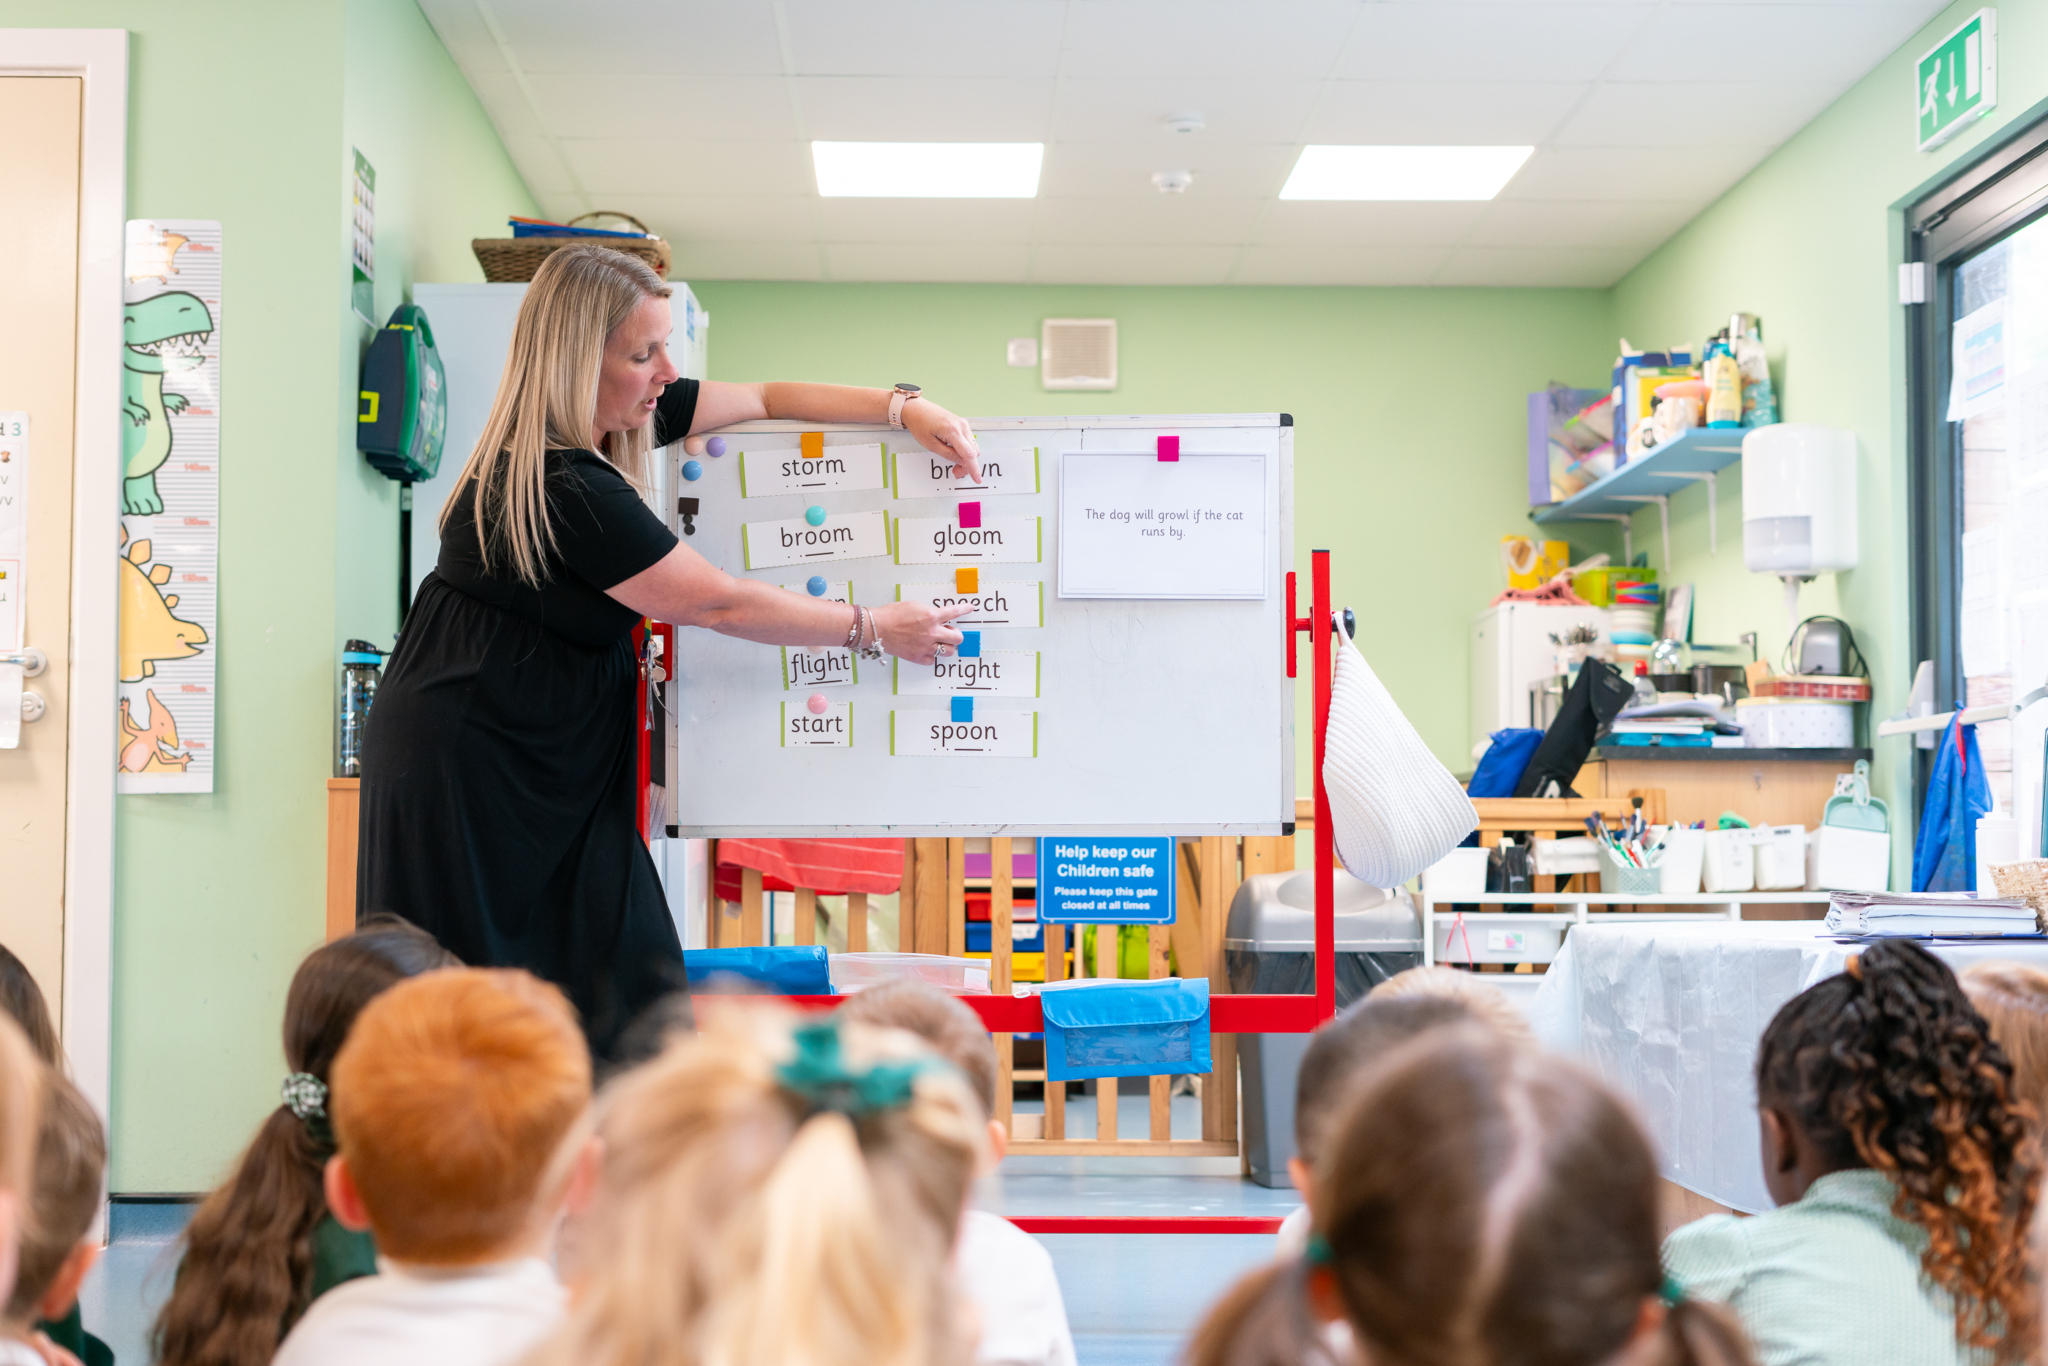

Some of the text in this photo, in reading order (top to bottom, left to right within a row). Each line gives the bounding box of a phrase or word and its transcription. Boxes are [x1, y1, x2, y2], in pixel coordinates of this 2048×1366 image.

[12, 422, 22, 437] 3
[781, 456, 846, 477] storm
[931, 458, 1002, 480] brn
[1084, 508, 1244, 524] The dog will growl if the cat
[780, 526, 854, 548] broom
[933, 524, 1004, 553] gloom
[1141, 525, 1186, 540] runs by.
[789, 651, 850, 684] flight
[934, 657, 1001, 686] bright
[791, 716, 843, 733] start
[930, 724, 998, 747] spoon
[1055, 844, 1157, 861] Help keep our
[1057, 863, 1155, 878] Children safe
[1054, 886, 1158, 898] Please keep this gate
[1061, 900, 1150, 910] closed at all times
